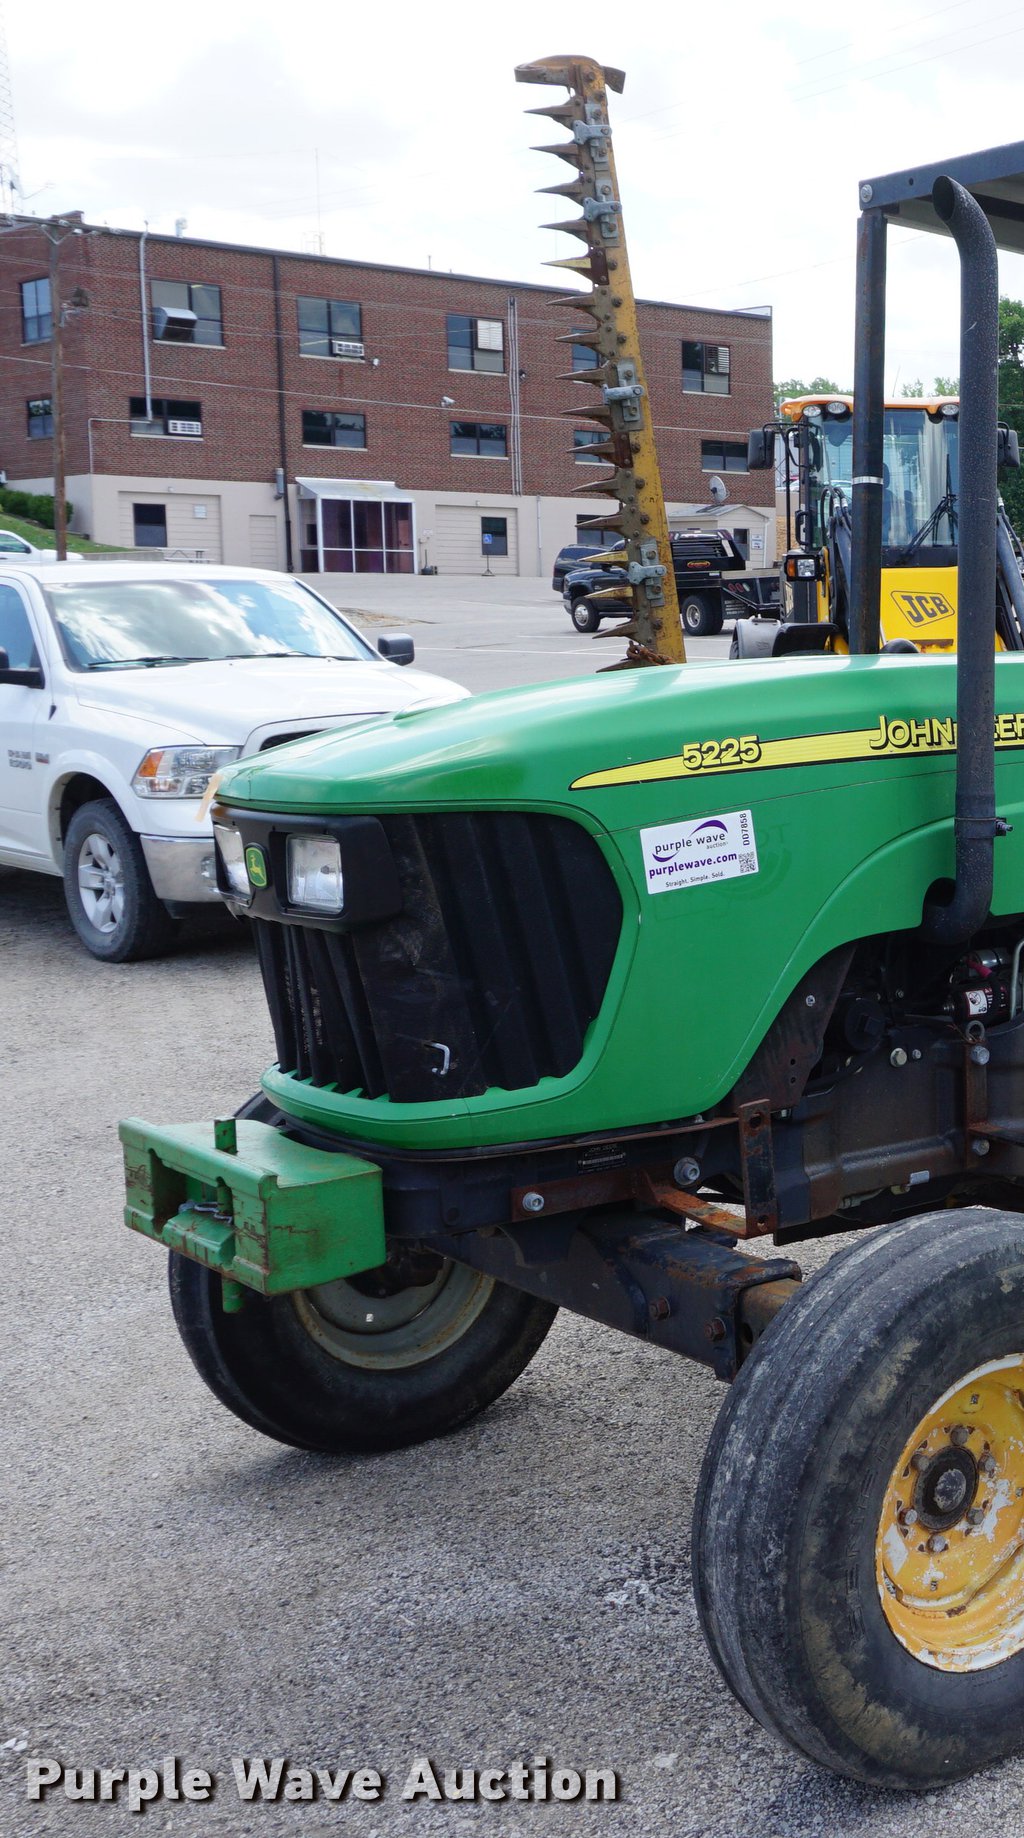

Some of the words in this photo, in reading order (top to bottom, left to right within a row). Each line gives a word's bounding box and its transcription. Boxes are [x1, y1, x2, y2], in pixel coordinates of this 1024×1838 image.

[901, 594, 949, 623] JCB
[869, 714, 956, 751] JOHN
[683, 734, 762, 770] 5225
[655, 837, 693, 855] purple
[695, 832, 726, 845] wave
[706, 842, 727, 850] auction
[649, 852, 738, 880] purplewave.com
[665, 877, 689, 888] Straight.
[690, 873, 711, 884] Simple.
[711, 870, 726, 879] Sold.
